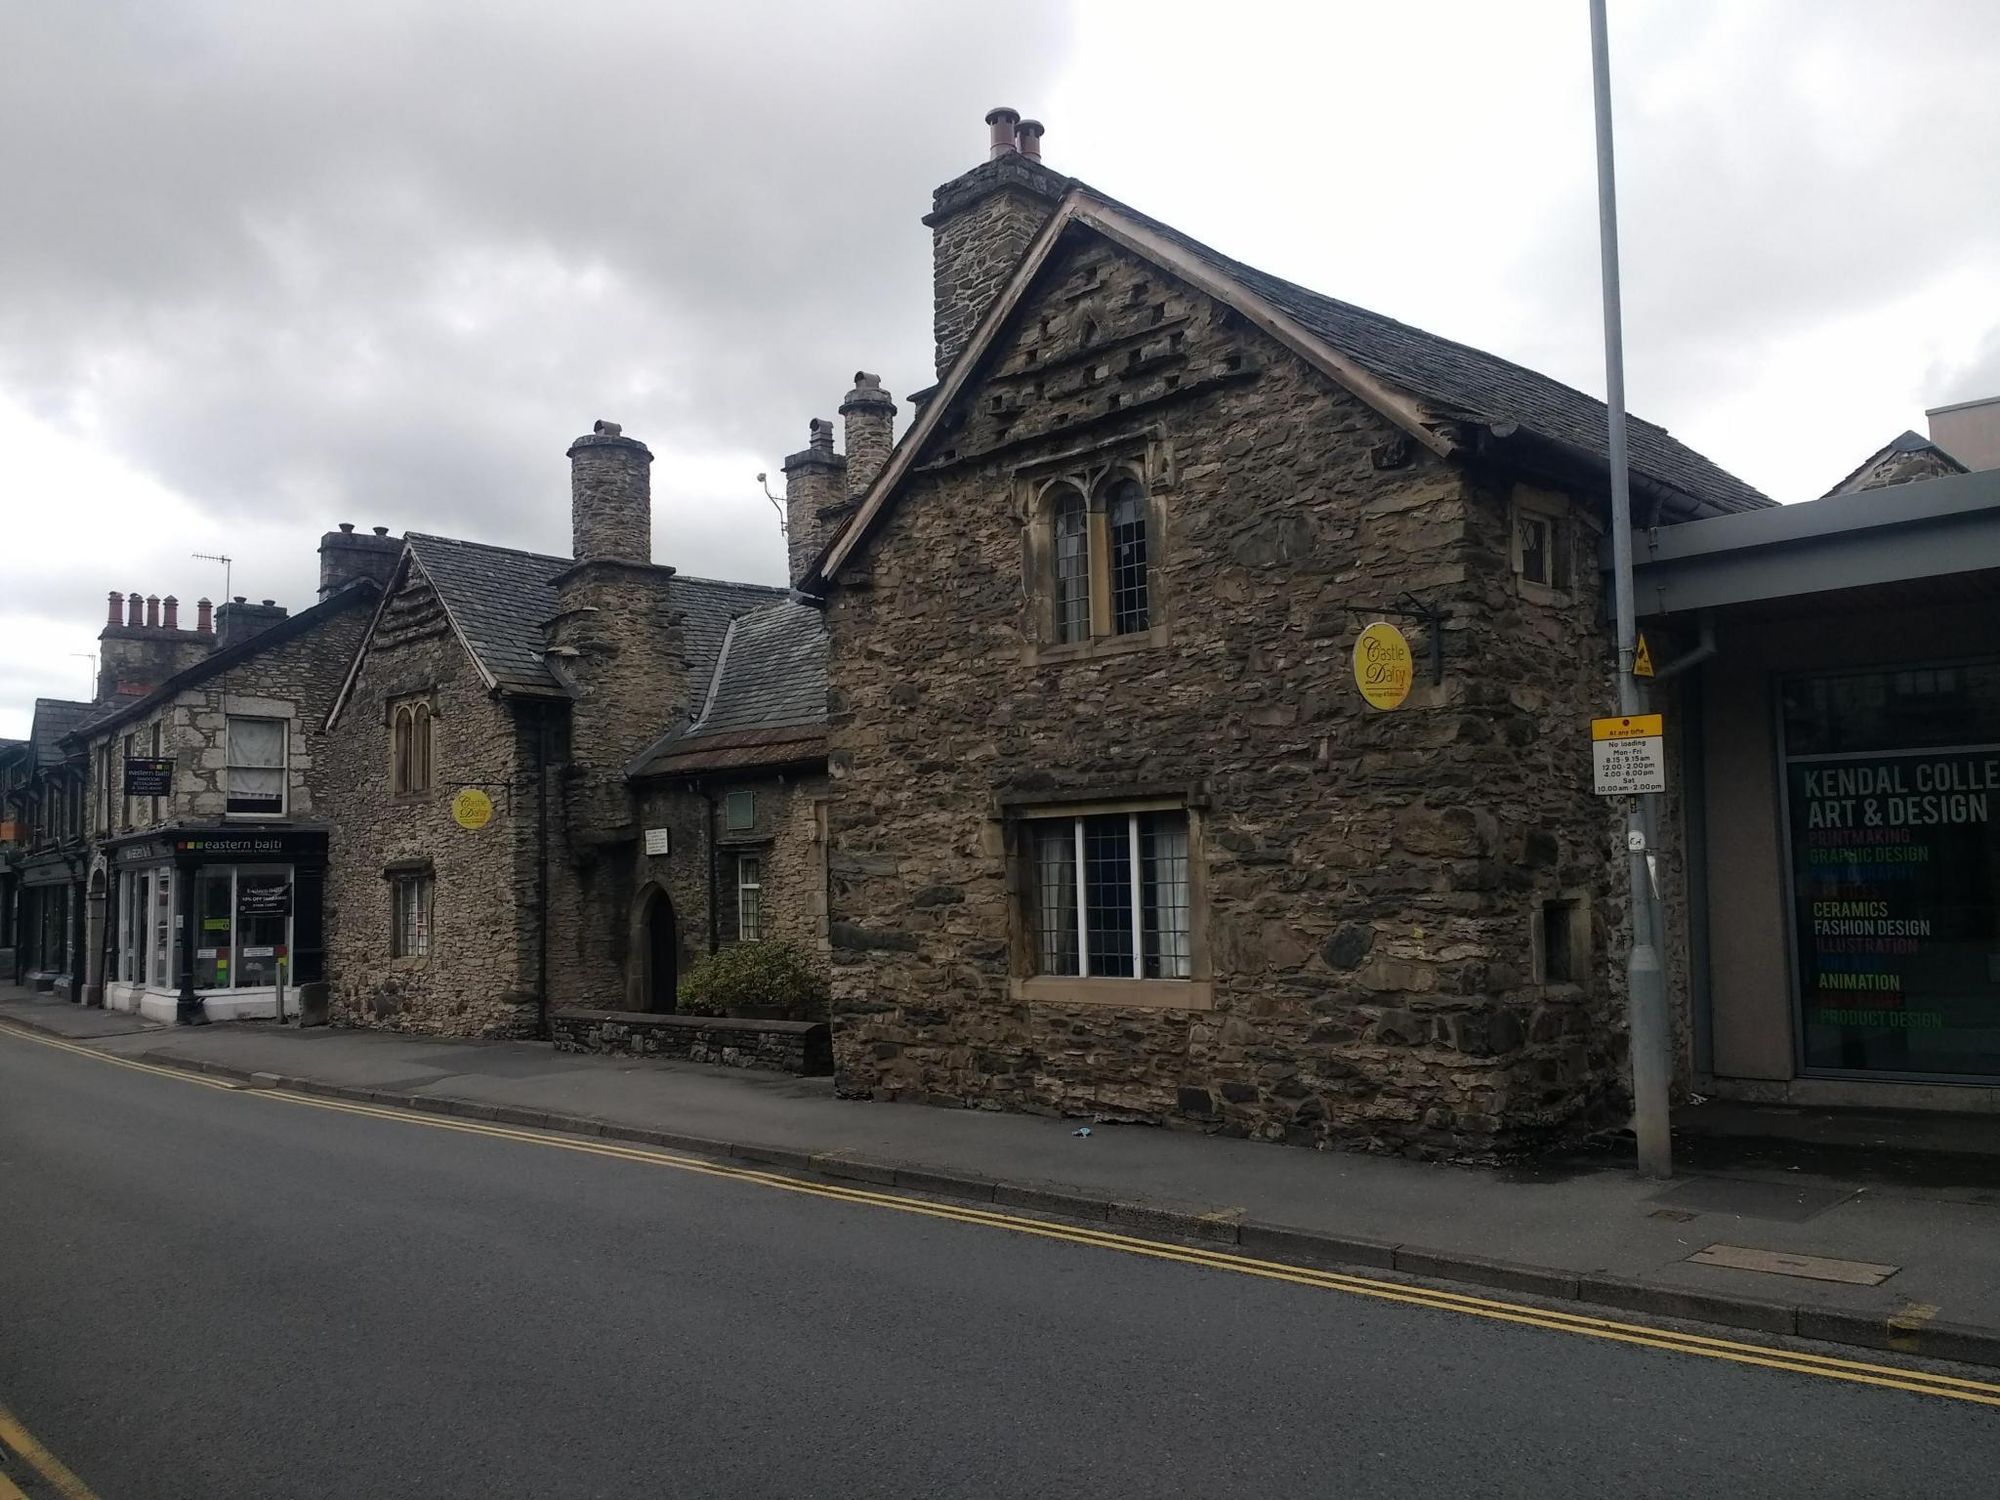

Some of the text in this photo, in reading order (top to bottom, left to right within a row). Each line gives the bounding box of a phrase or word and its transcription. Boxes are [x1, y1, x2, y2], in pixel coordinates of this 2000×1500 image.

[1363, 636, 1404, 662] Castle
[1365, 663, 1405, 687] Dairy
[1804, 766, 1909, 798] KENDAL
[1808, 794, 1988, 829] ART & DESIGN
[205, 838, 282, 849] eastern balti
[1809, 846, 1928, 864] GRAPHIC DESIGN
[1812, 901, 1888, 918] CERAMICS
[1814, 920, 1930, 937] FASHION DESIGN
[1816, 938, 1919, 954] ILLUSTRATION
[1819, 972, 1900, 991] ANIMATION
[1820, 1009, 1942, 1029] PRODUCT DESIGN
